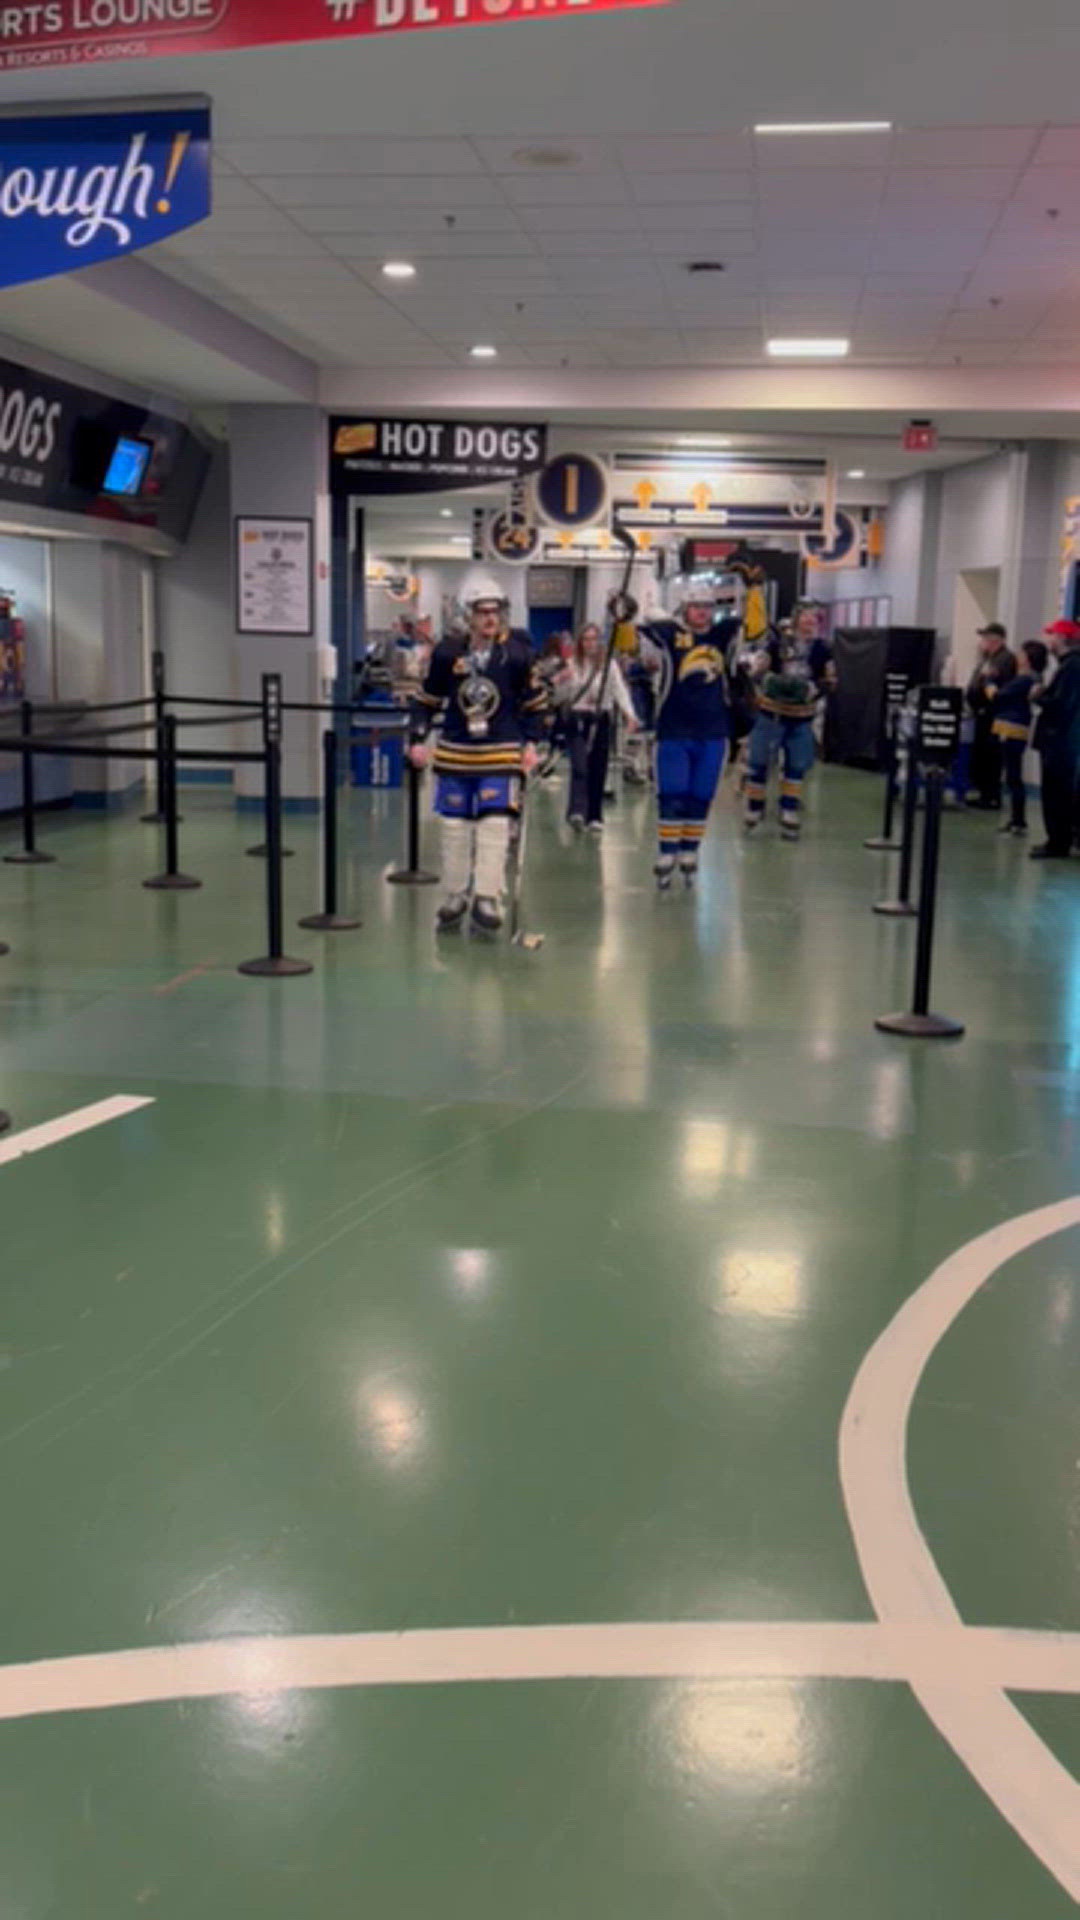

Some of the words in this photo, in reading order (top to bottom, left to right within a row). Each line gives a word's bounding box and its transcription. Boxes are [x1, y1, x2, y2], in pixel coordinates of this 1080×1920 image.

[0, 3, 62, 37] RTS
[73, 0, 213, 29] LOUNGE
[1, 131, 192, 247] ough!
[0, 388, 61, 462] OGS
[382, 423, 443, 457] HOT
[455, 426, 540, 461] DOGS
